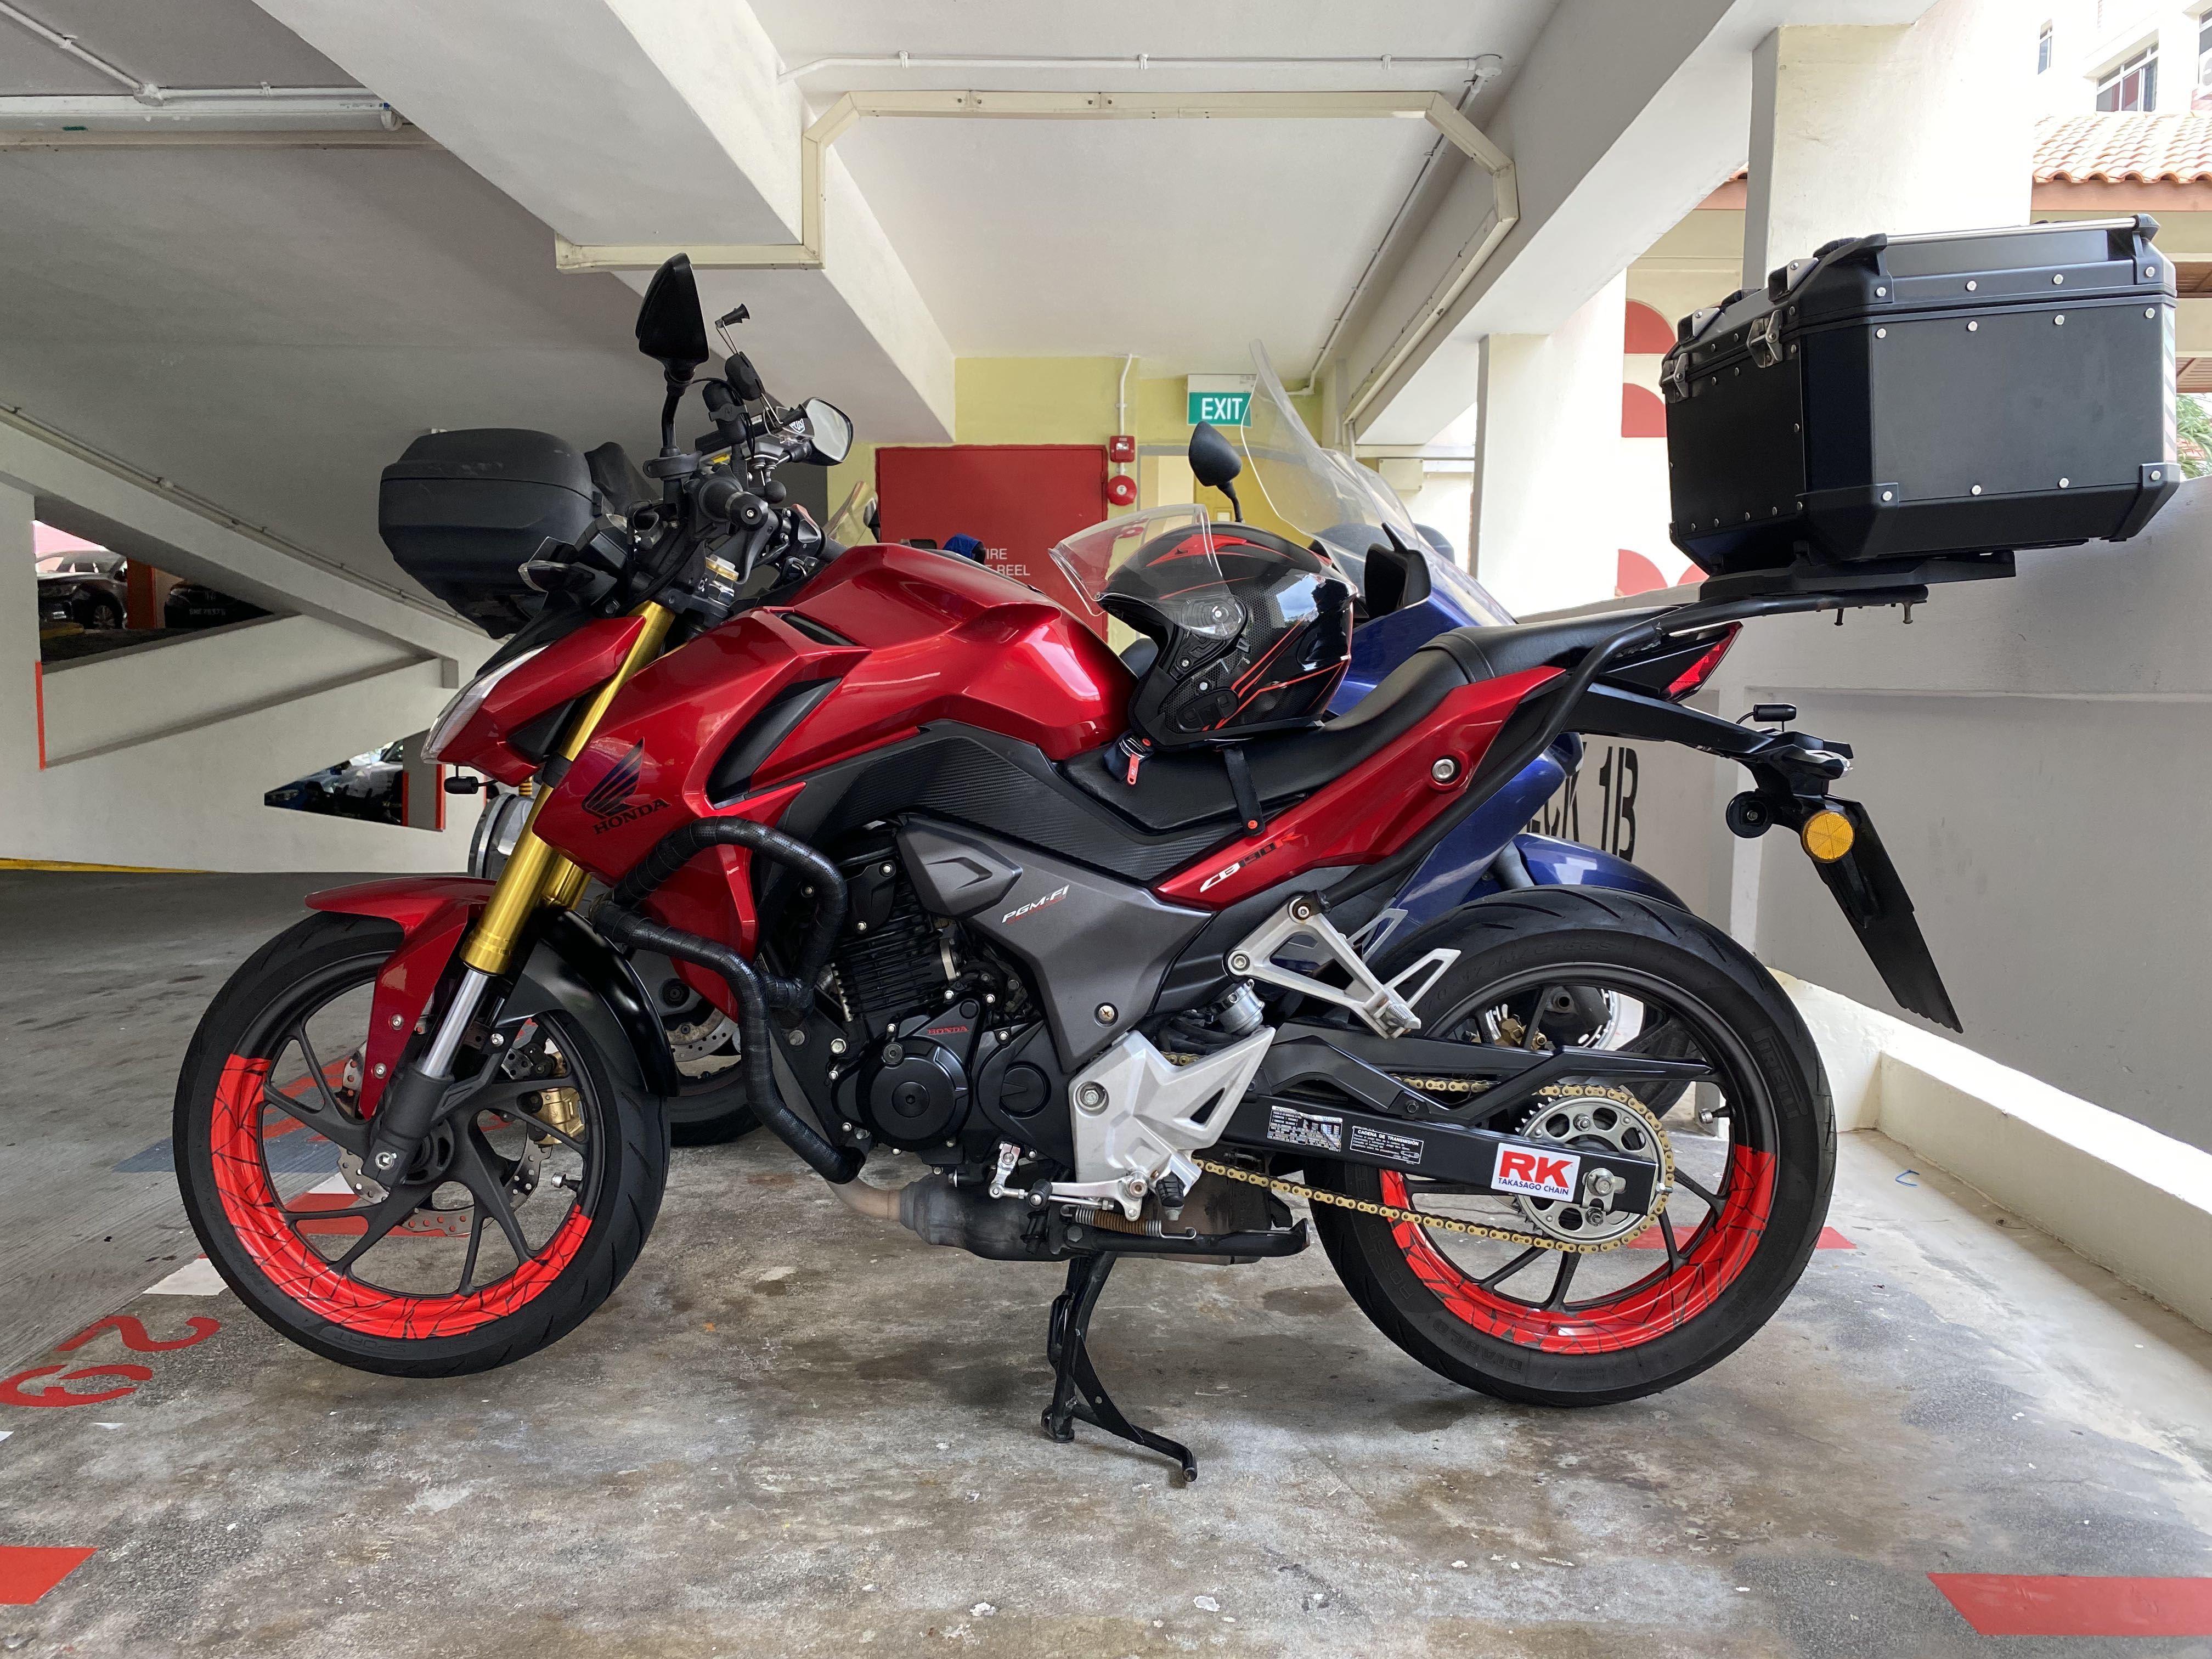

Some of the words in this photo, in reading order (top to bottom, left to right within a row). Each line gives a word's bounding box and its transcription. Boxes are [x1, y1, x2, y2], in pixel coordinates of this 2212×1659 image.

[1201, 397, 1243, 420] EXIT
[984, 548, 1008, 560] IRE
[997, 564, 1031, 576] REEL
[592, 797, 673, 835] HONDA
[1002, 884, 1070, 923] PGM-FI
[927, 1026, 969, 1035] HONDA
[1751, 1026, 1808, 1120] PIRELLI
[1499, 1150, 1573, 1188] RK
[1498, 1177, 1542, 1190] TAKASAGO
[1544, 1185, 1569, 1195] CHAIN
[1367, 1223, 1414, 1301] ROSSO
[333, 1331, 407, 1353] SPORT
[1432, 1319, 1523, 1373] DIABLO
